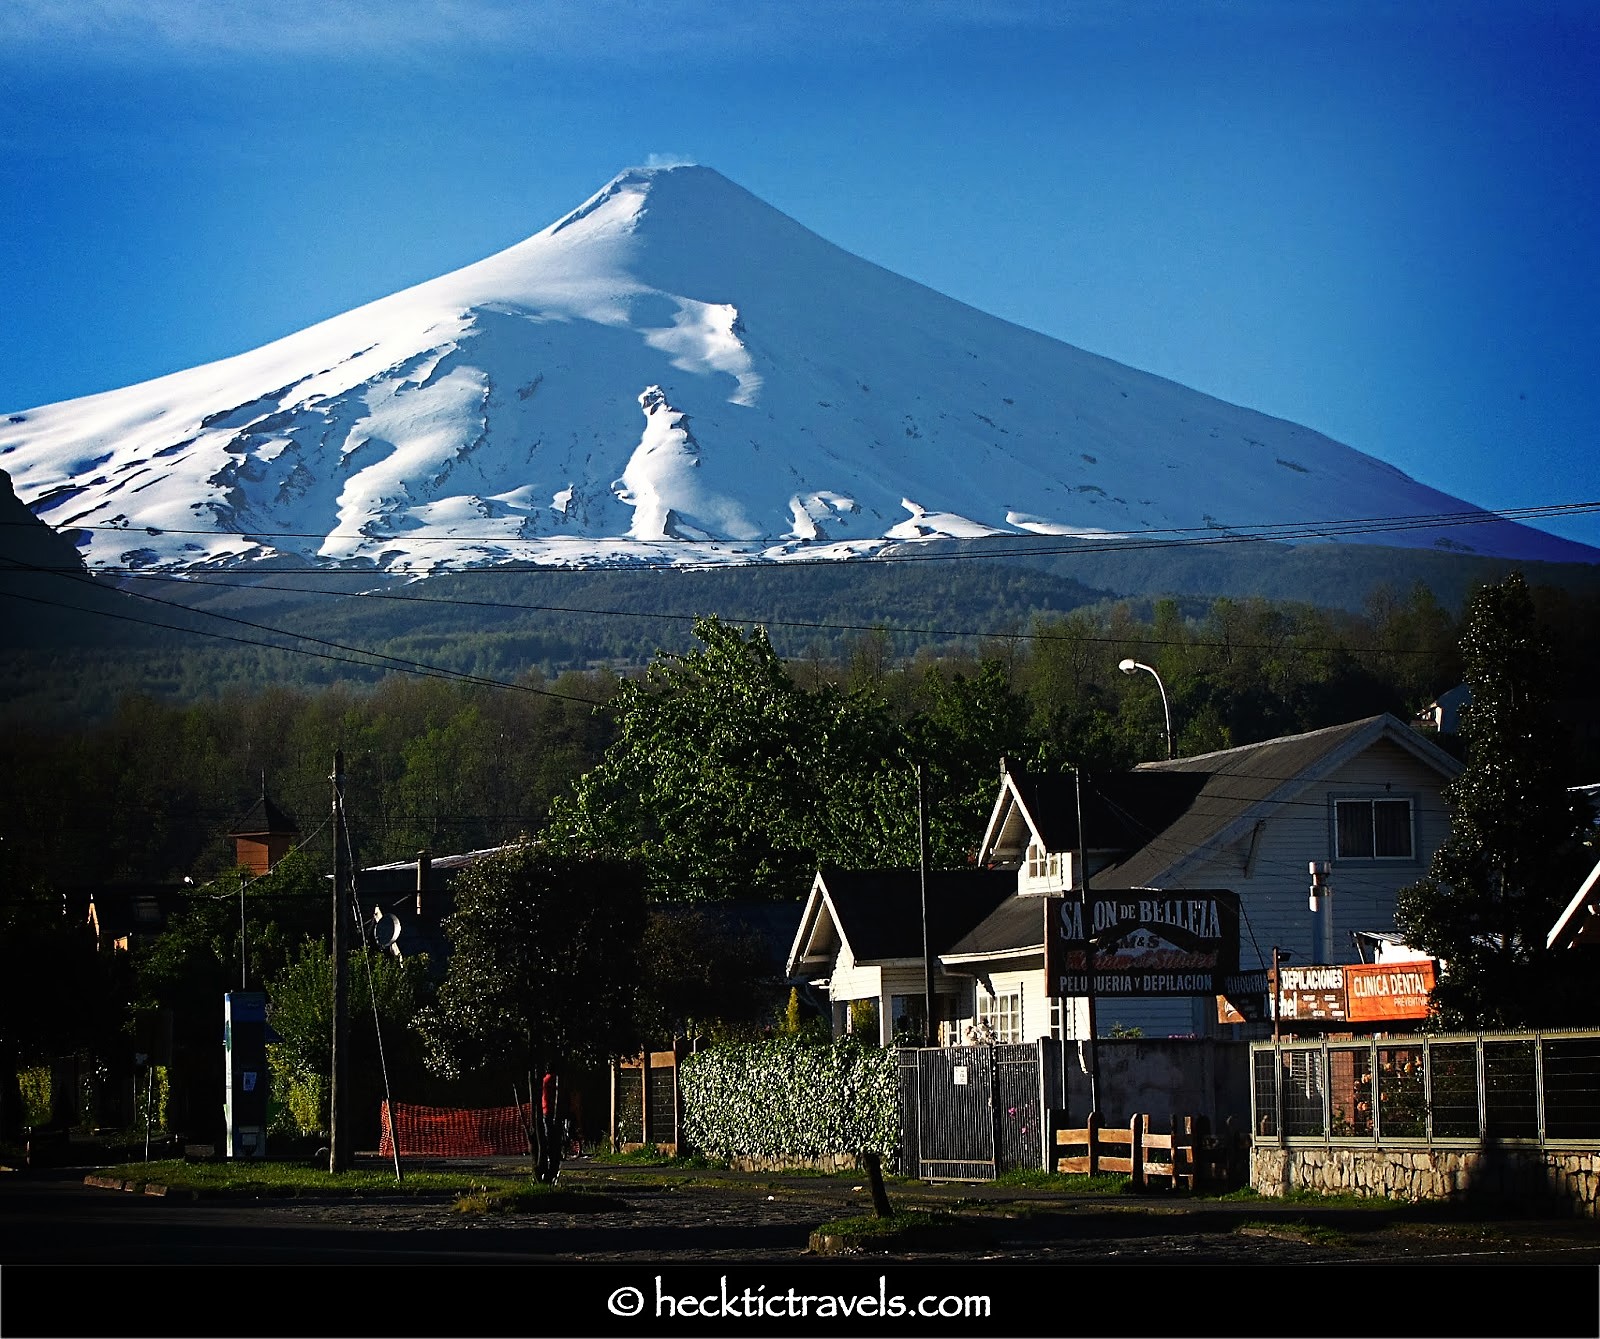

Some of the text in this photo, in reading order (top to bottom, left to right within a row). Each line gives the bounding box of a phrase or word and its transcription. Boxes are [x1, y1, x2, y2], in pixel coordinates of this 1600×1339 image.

[1060, 899, 1222, 940] SAON DE BELLEZA
[1059, 975, 1132, 992] PELUUERIA
[1143, 974, 1212, 991] DEPILACION
[1281, 969, 1343, 990] DEPILACIONES
[1353, 973, 1428, 997] CLINICA DENTAL
